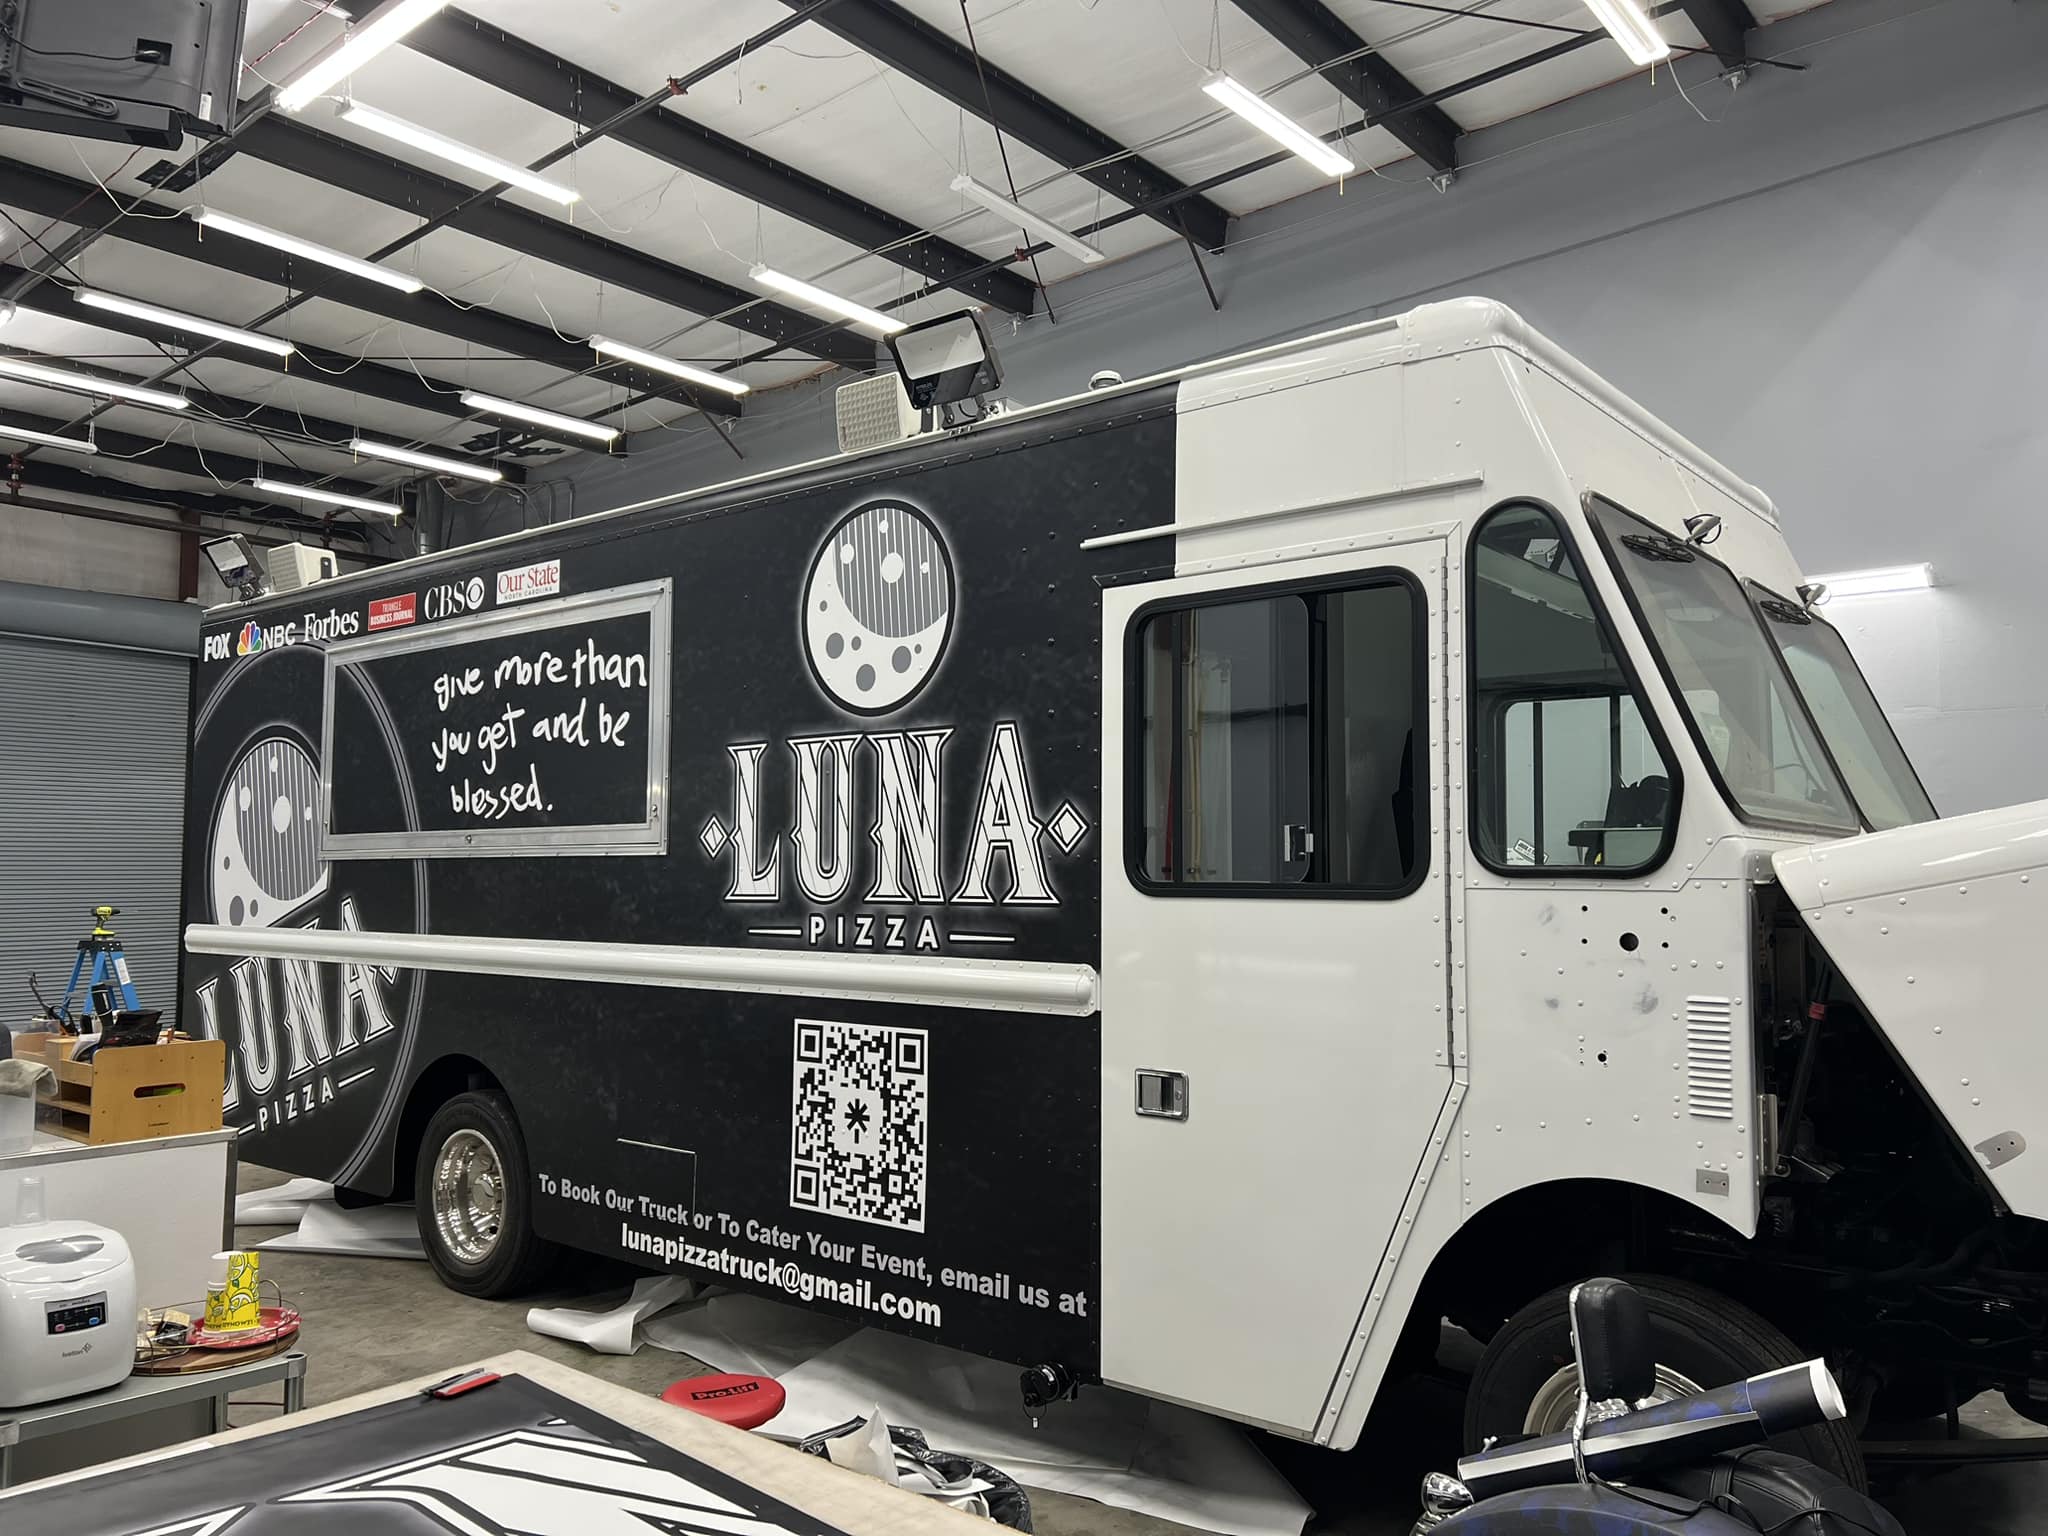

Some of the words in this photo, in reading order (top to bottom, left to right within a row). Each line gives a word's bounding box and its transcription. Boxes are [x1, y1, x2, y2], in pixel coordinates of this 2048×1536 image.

[498, 573, 526, 595] Our
[527, 564, 560, 588] State
[503, 592, 522, 601] NORTH
[524, 586, 553, 598] CAROLINA
[370, 612, 393, 626] BUSINESS
[393, 608, 414, 622] JOURNAL
[424, 580, 466, 620] CBS
[262, 621, 297, 651] NBC
[303, 607, 360, 643] Forbes
[203, 632, 231, 662] FOX
[433, 667, 484, 712] give
[494, 651, 568, 689] more
[571, 637, 648, 688] than
[431, 727, 472, 773] you
[477, 702, 526, 775] get
[532, 697, 590, 747] and
[598, 702, 630, 747] be
[450, 762, 553, 820] blessed.
[724, 721, 1061, 905] LUNA
[809, 916, 939, 949] PIZZA
[258, 1077, 334, 1131] PIZZA
[538, 1173, 557, 1195] To
[561, 1178, 601, 1206] Book
[605, 1188, 635, 1213] Our
[638, 1195, 689, 1227] Truck
[693, 1212, 713, 1231] or
[717, 1211, 741, 1238] To
[745, 1218, 801, 1251] Cater
[806, 1231, 856, 1264] Your
[860, 1243, 933, 1288] Event,
[940, 1266, 1010, 1300] email
[1018, 1284, 1050, 1309] us
[1058, 1291, 1087, 1317] at
[621, 1221, 942, 1328] lunapizzatruck@gmail.com
